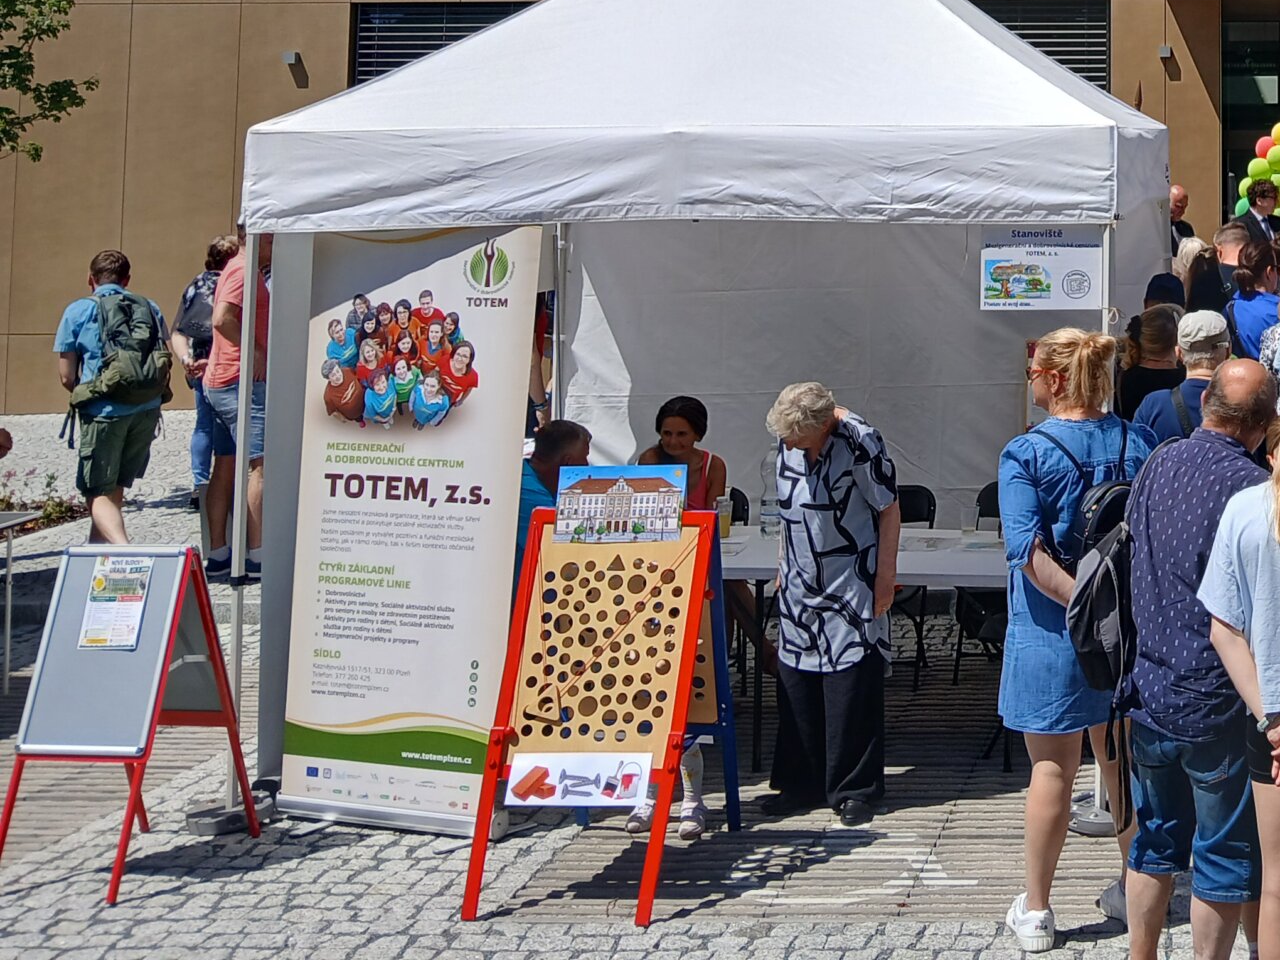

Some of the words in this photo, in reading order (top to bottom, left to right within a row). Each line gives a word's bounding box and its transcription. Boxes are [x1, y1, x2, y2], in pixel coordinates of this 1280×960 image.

[1011, 229, 1063, 238] Stanoviště
[466, 297, 508, 308] TOTEM
[327, 442, 405, 453] MEZIGENERAČNÍ
[325, 455, 333, 463] A
[334, 455, 415, 467] DOBROVOLNICKÉ
[417, 458, 464, 468] CENTRUM
[325, 473, 438, 508] TOTEM,
[444, 485, 491, 505] z.s.
[319, 561, 346, 572] ČTYŘI
[348, 562, 395, 575] ZÁKLADNÍ
[318, 575, 384, 588] PROGRAMOVÉ
[387, 579, 411, 589] LINIE
[313, 648, 341, 659] SÍDLO
[401, 751, 472, 765] www.totemplzen.cz
